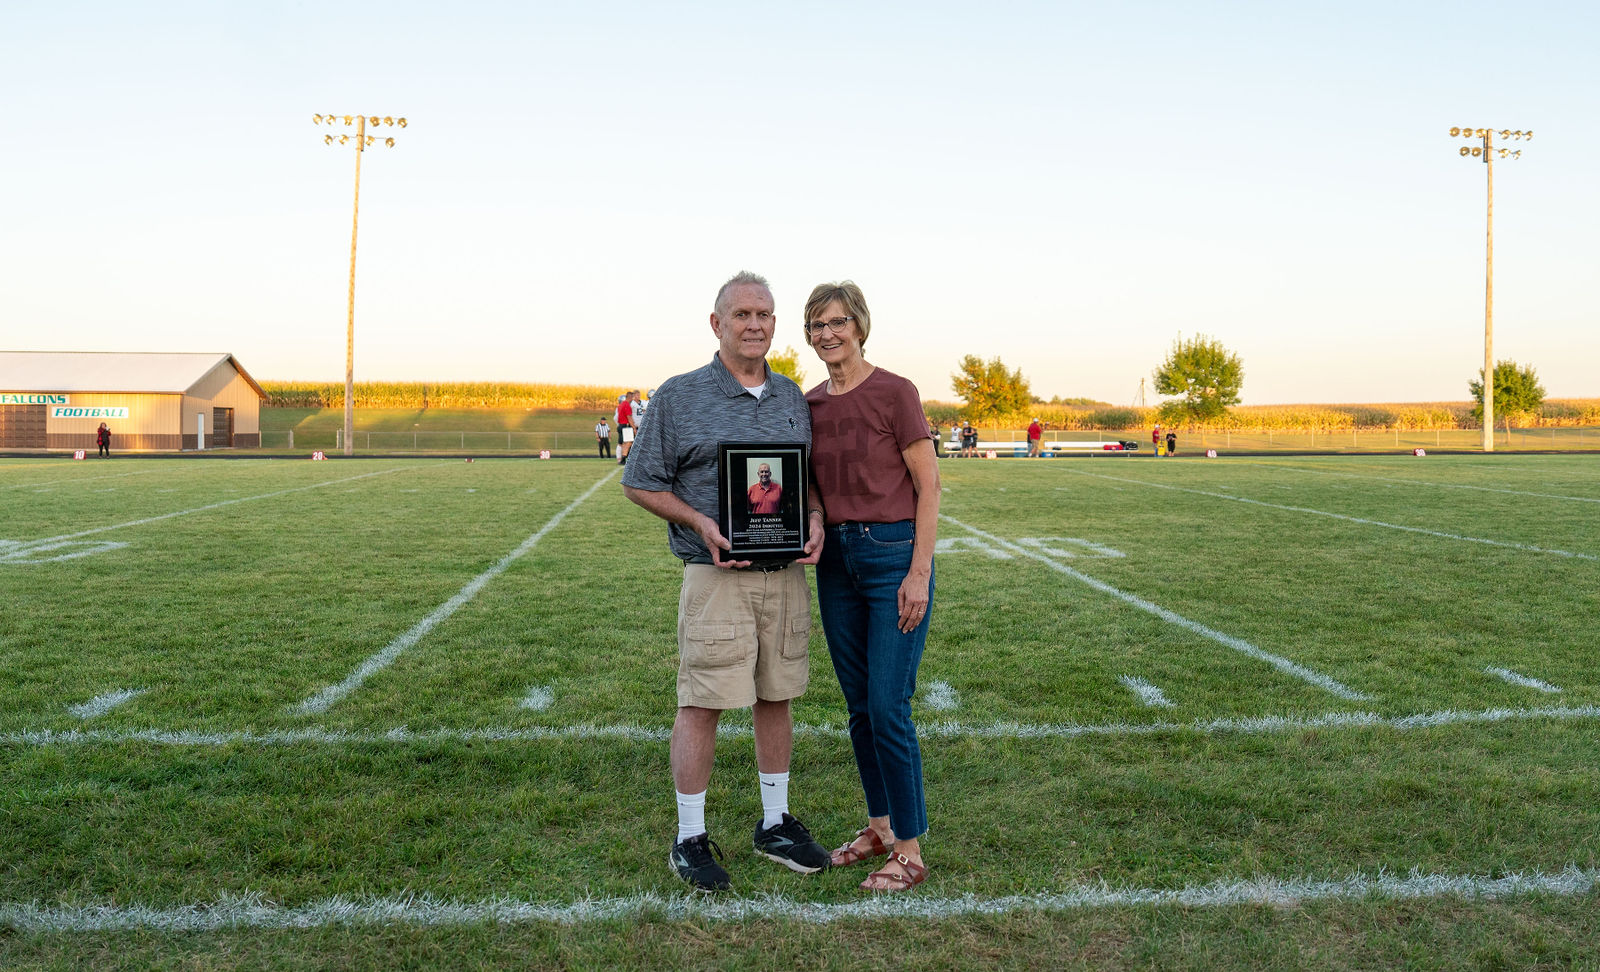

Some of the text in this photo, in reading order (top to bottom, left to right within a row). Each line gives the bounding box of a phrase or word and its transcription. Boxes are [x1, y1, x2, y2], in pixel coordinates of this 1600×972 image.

[2, 394, 66, 404] FALCONS
[55, 407, 126, 417] FOOTBALL
[75, 450, 84, 460] 10
[313, 451, 323, 461] 20
[540, 450, 550, 460] 30
[1207, 449, 1217, 458] 40
